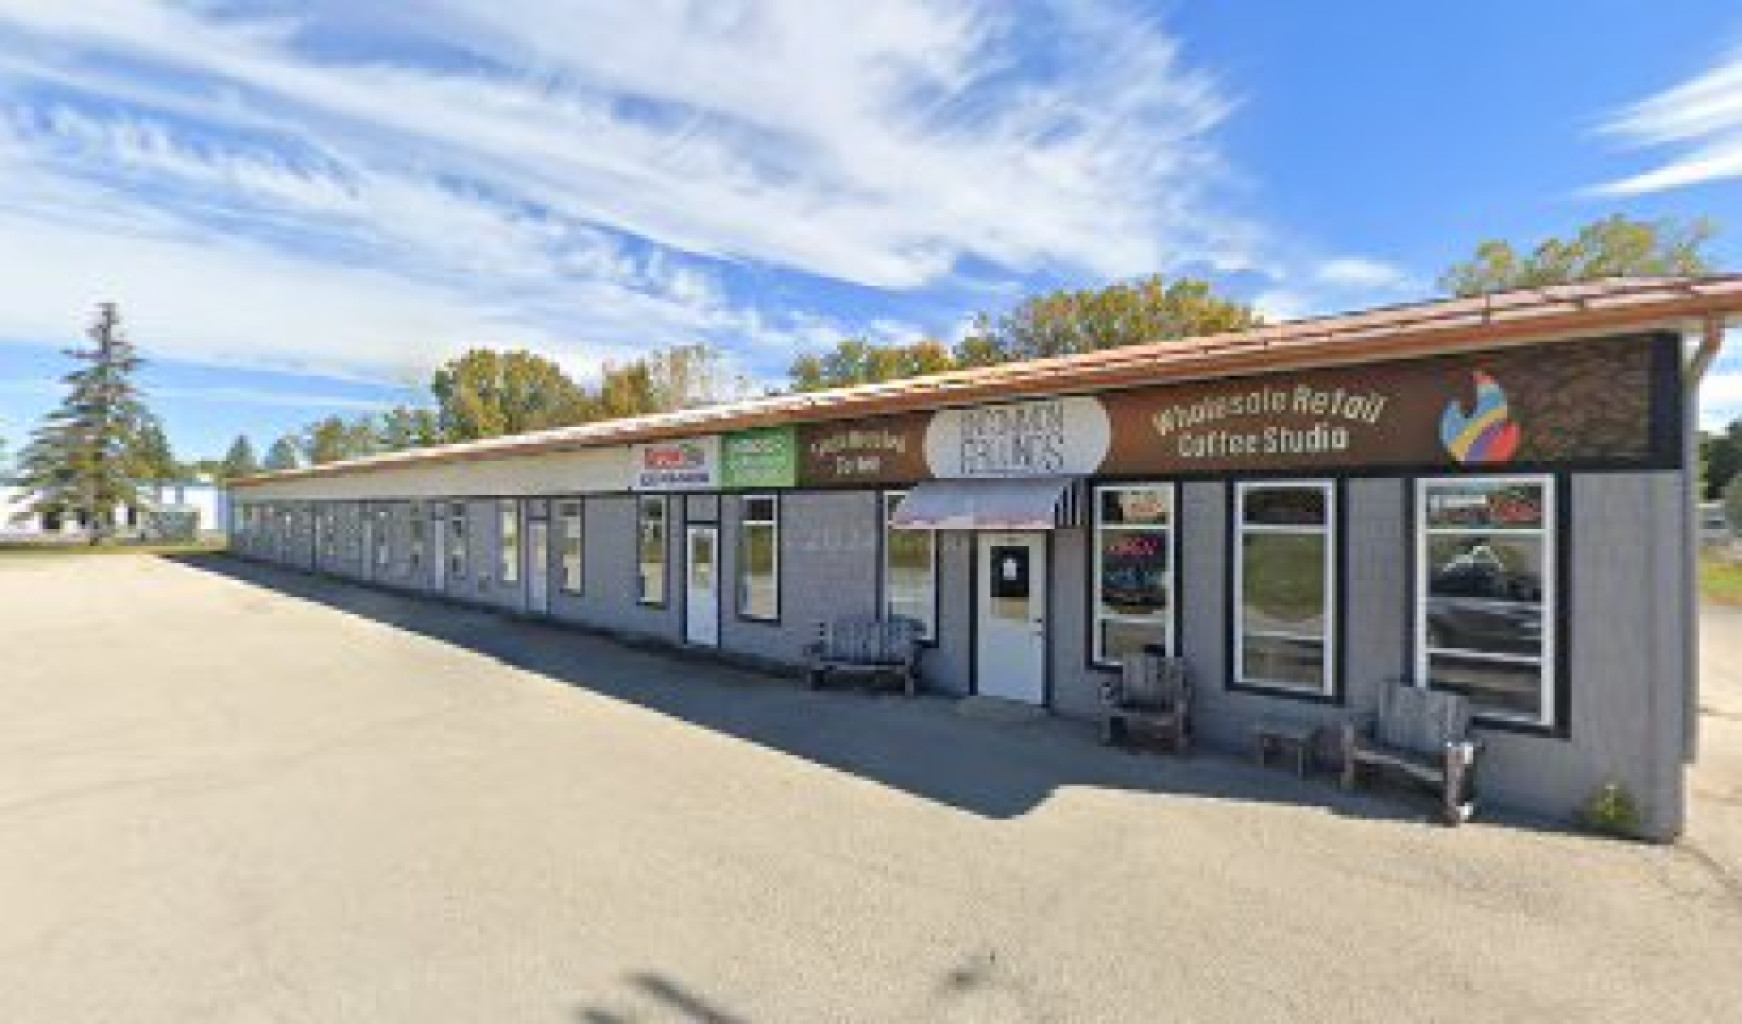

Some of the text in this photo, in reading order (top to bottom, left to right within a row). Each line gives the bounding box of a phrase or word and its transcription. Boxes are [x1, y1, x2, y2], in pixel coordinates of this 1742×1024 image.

[1153, 384, 1388, 436] Wholesale Retail
[1178, 421, 1349, 457] Coffee Studio
